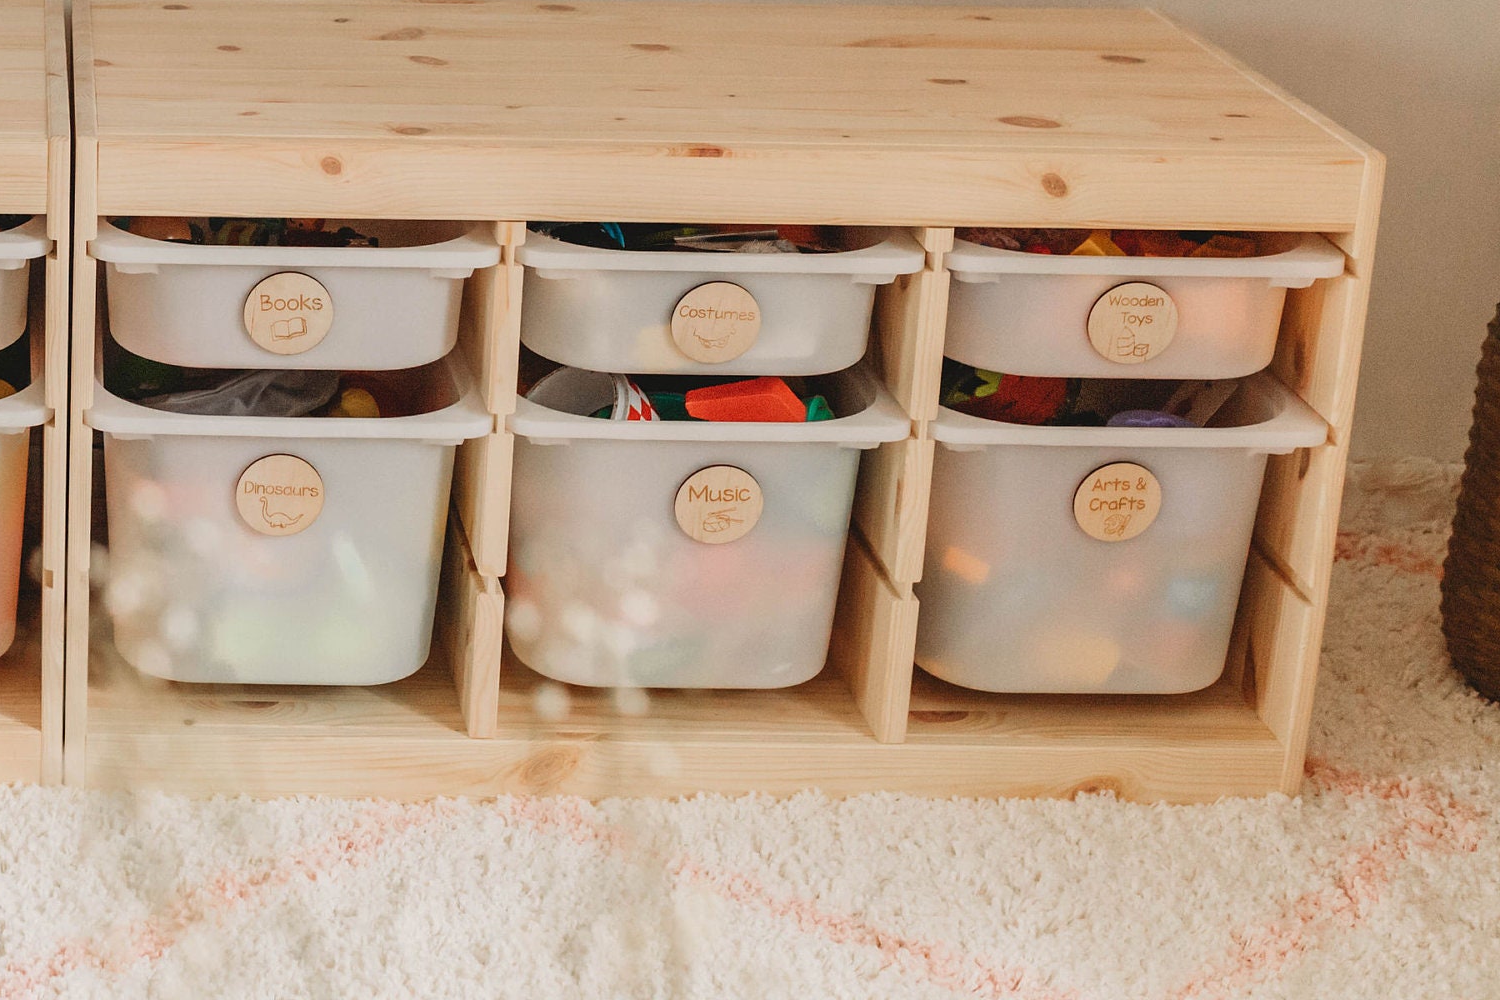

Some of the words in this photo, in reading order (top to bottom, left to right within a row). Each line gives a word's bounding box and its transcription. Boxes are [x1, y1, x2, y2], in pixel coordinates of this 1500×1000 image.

[259, 293, 323, 312] Books
[1108, 294, 1165, 307] Wooden
[678, 305, 756, 321] Costumes
[1120, 312, 1153, 326] Toys
[243, 481, 320, 497] Dinosaurs
[1091, 477, 1131, 492] Arts
[1135, 476, 1147, 491] &
[687, 484, 750, 503] Music
[1088, 496, 1146, 511] Crafts
